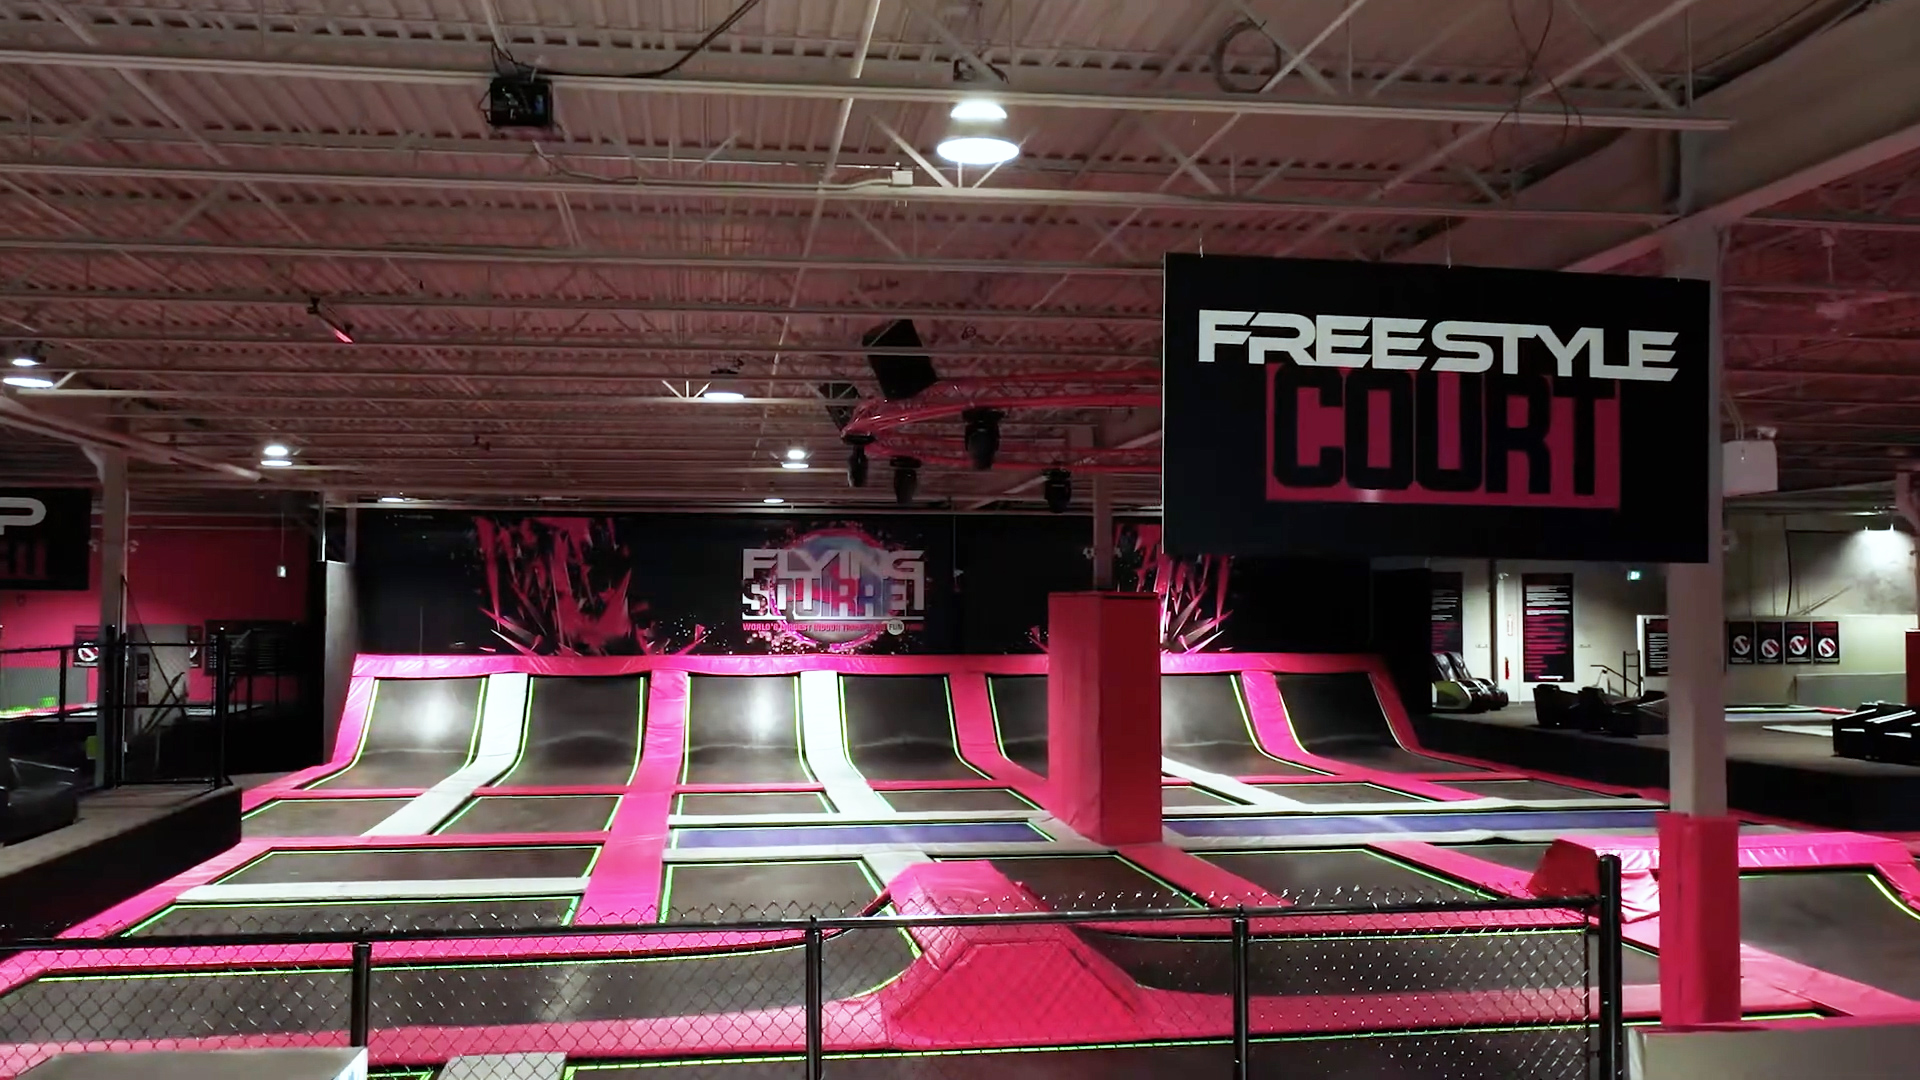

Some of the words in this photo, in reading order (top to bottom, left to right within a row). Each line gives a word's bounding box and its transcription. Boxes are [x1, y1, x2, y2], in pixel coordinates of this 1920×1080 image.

[1198, 309, 1679, 382] FREESTYLE
[1272, 365, 1616, 495] COURT
[742, 548, 925, 580] FLYING
[741, 577, 925, 620] SQUIRREL
[742, 622, 778, 632] WORLD'S
[888, 623, 903, 631] FUN
